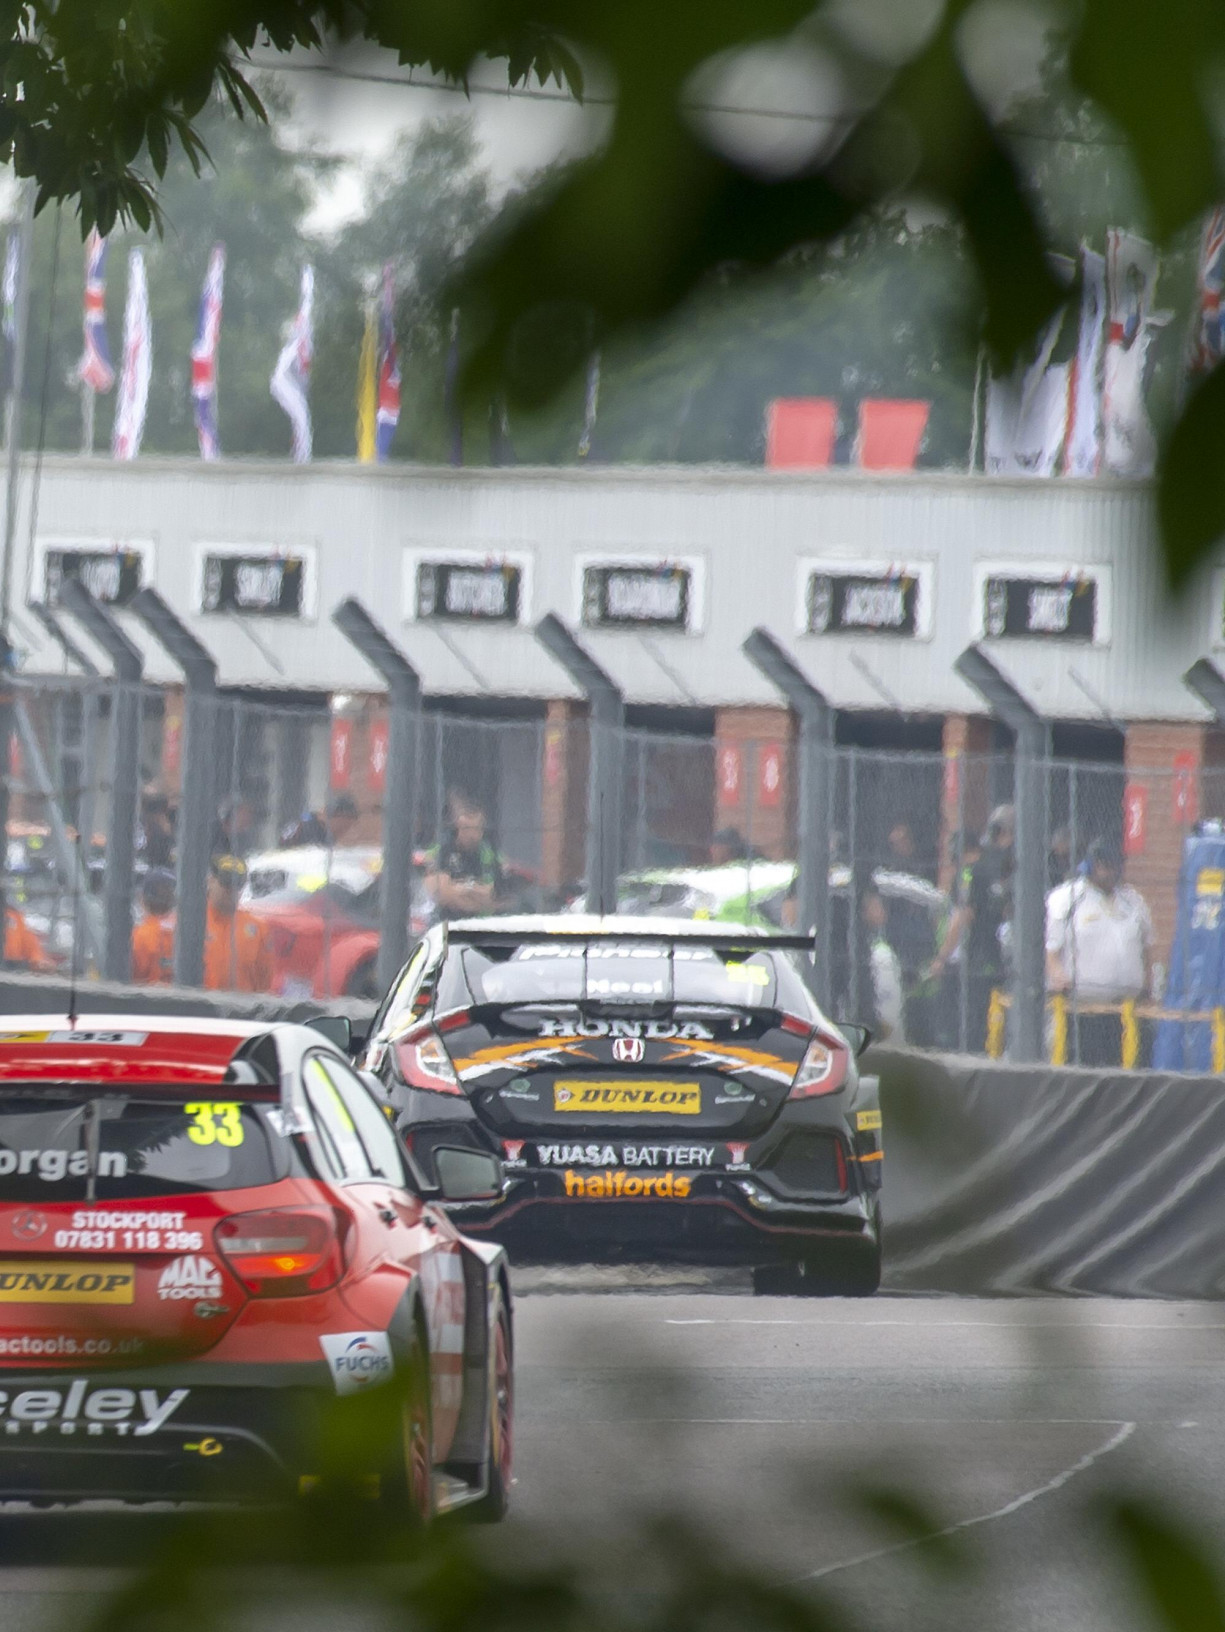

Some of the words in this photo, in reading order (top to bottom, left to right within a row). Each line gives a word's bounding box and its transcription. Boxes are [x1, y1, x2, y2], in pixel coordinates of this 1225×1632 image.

[69, 1031, 123, 1043] 33
[538, 1018, 715, 1040] HONDA
[580, 1088, 698, 1105] DUNLOP
[184, 1102, 244, 1147] 33
[536, 1145, 619, 1166] YUASA
[623, 1146, 715, 1166] BATTERY
[564, 1169, 692, 1197] halfords
[72, 1211, 187, 1229] STOCKPORT
[54, 1230, 116, 1248] 07831
[122, 1231, 161, 1249] 118
[164, 1232, 204, 1250] 396
[158, 1255, 223, 1286] MAC
[158, 1287, 223, 1299] TOOLS
[335, 1356, 389, 1372] FUCHS
